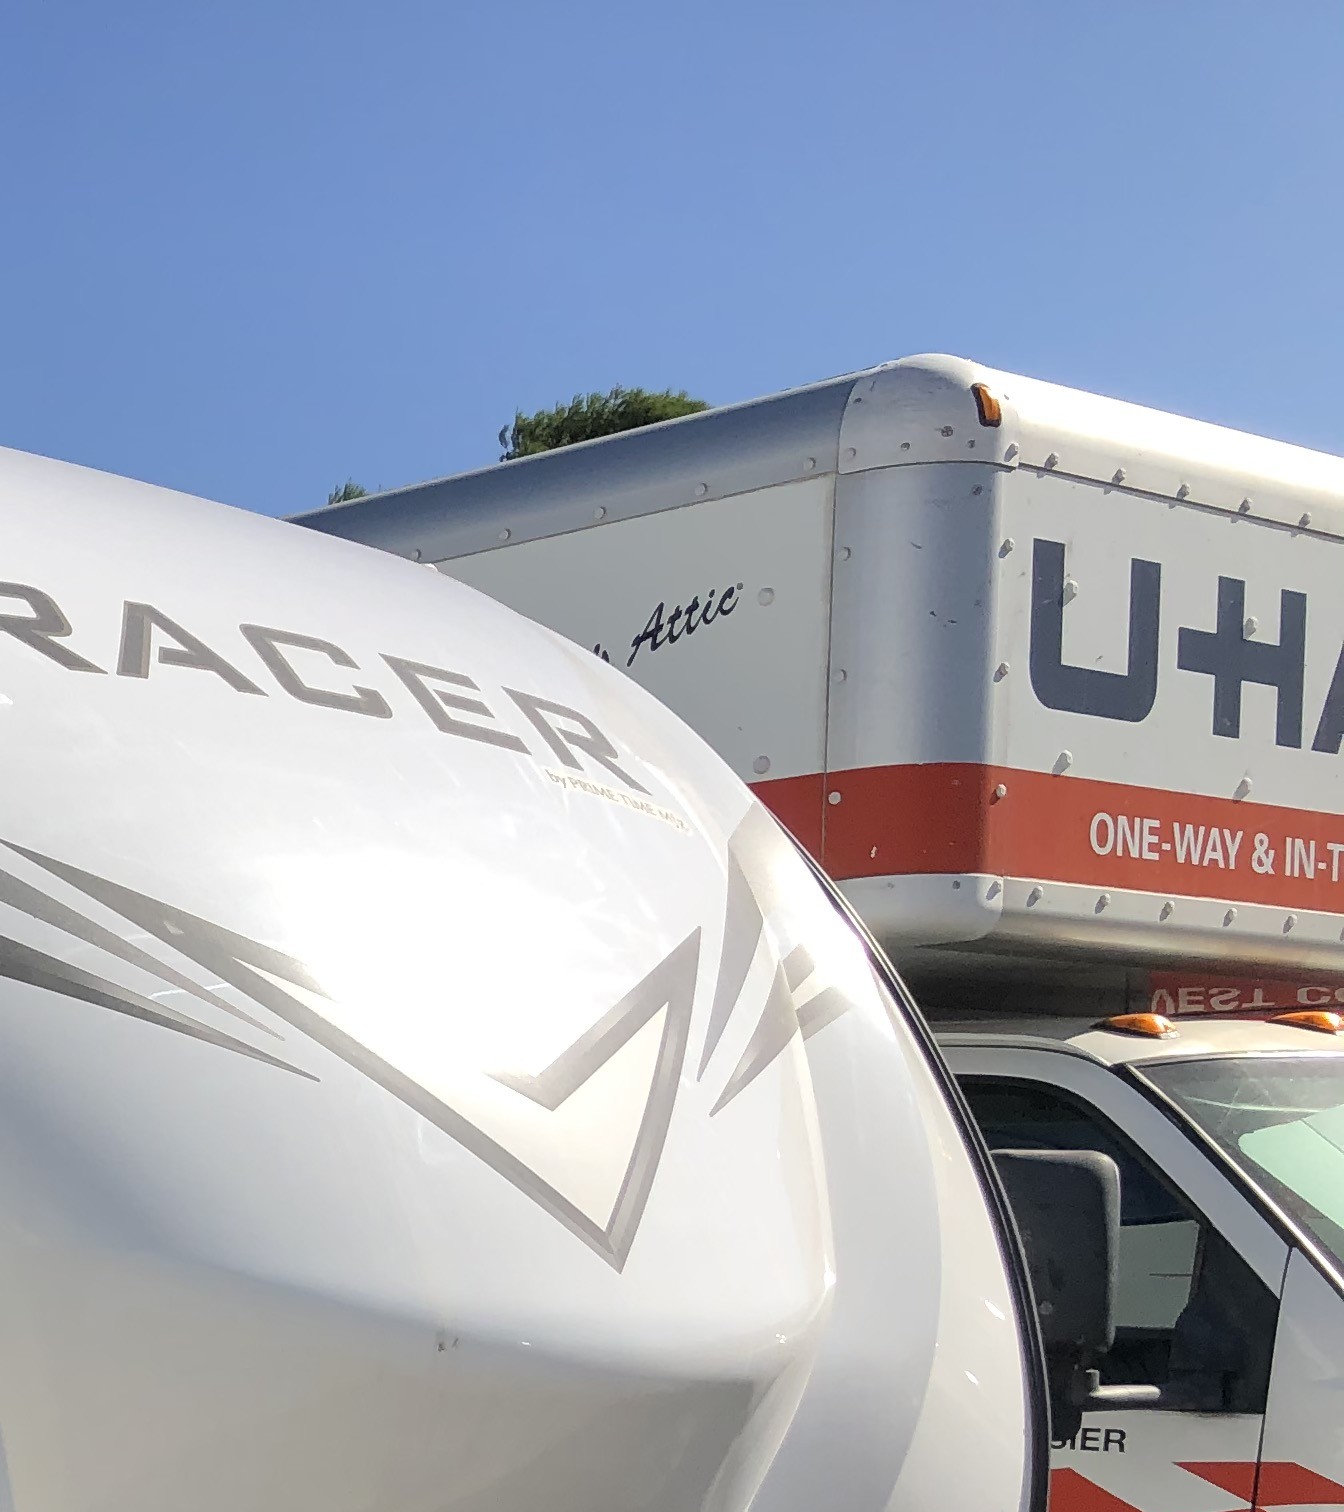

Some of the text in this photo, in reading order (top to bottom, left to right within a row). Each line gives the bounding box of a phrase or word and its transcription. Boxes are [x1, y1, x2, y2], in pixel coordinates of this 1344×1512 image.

[627, 585, 740, 667] Attic
[1089, 811, 1243, 870] ONE-WAY
[1251, 832, 1275, 875] &
